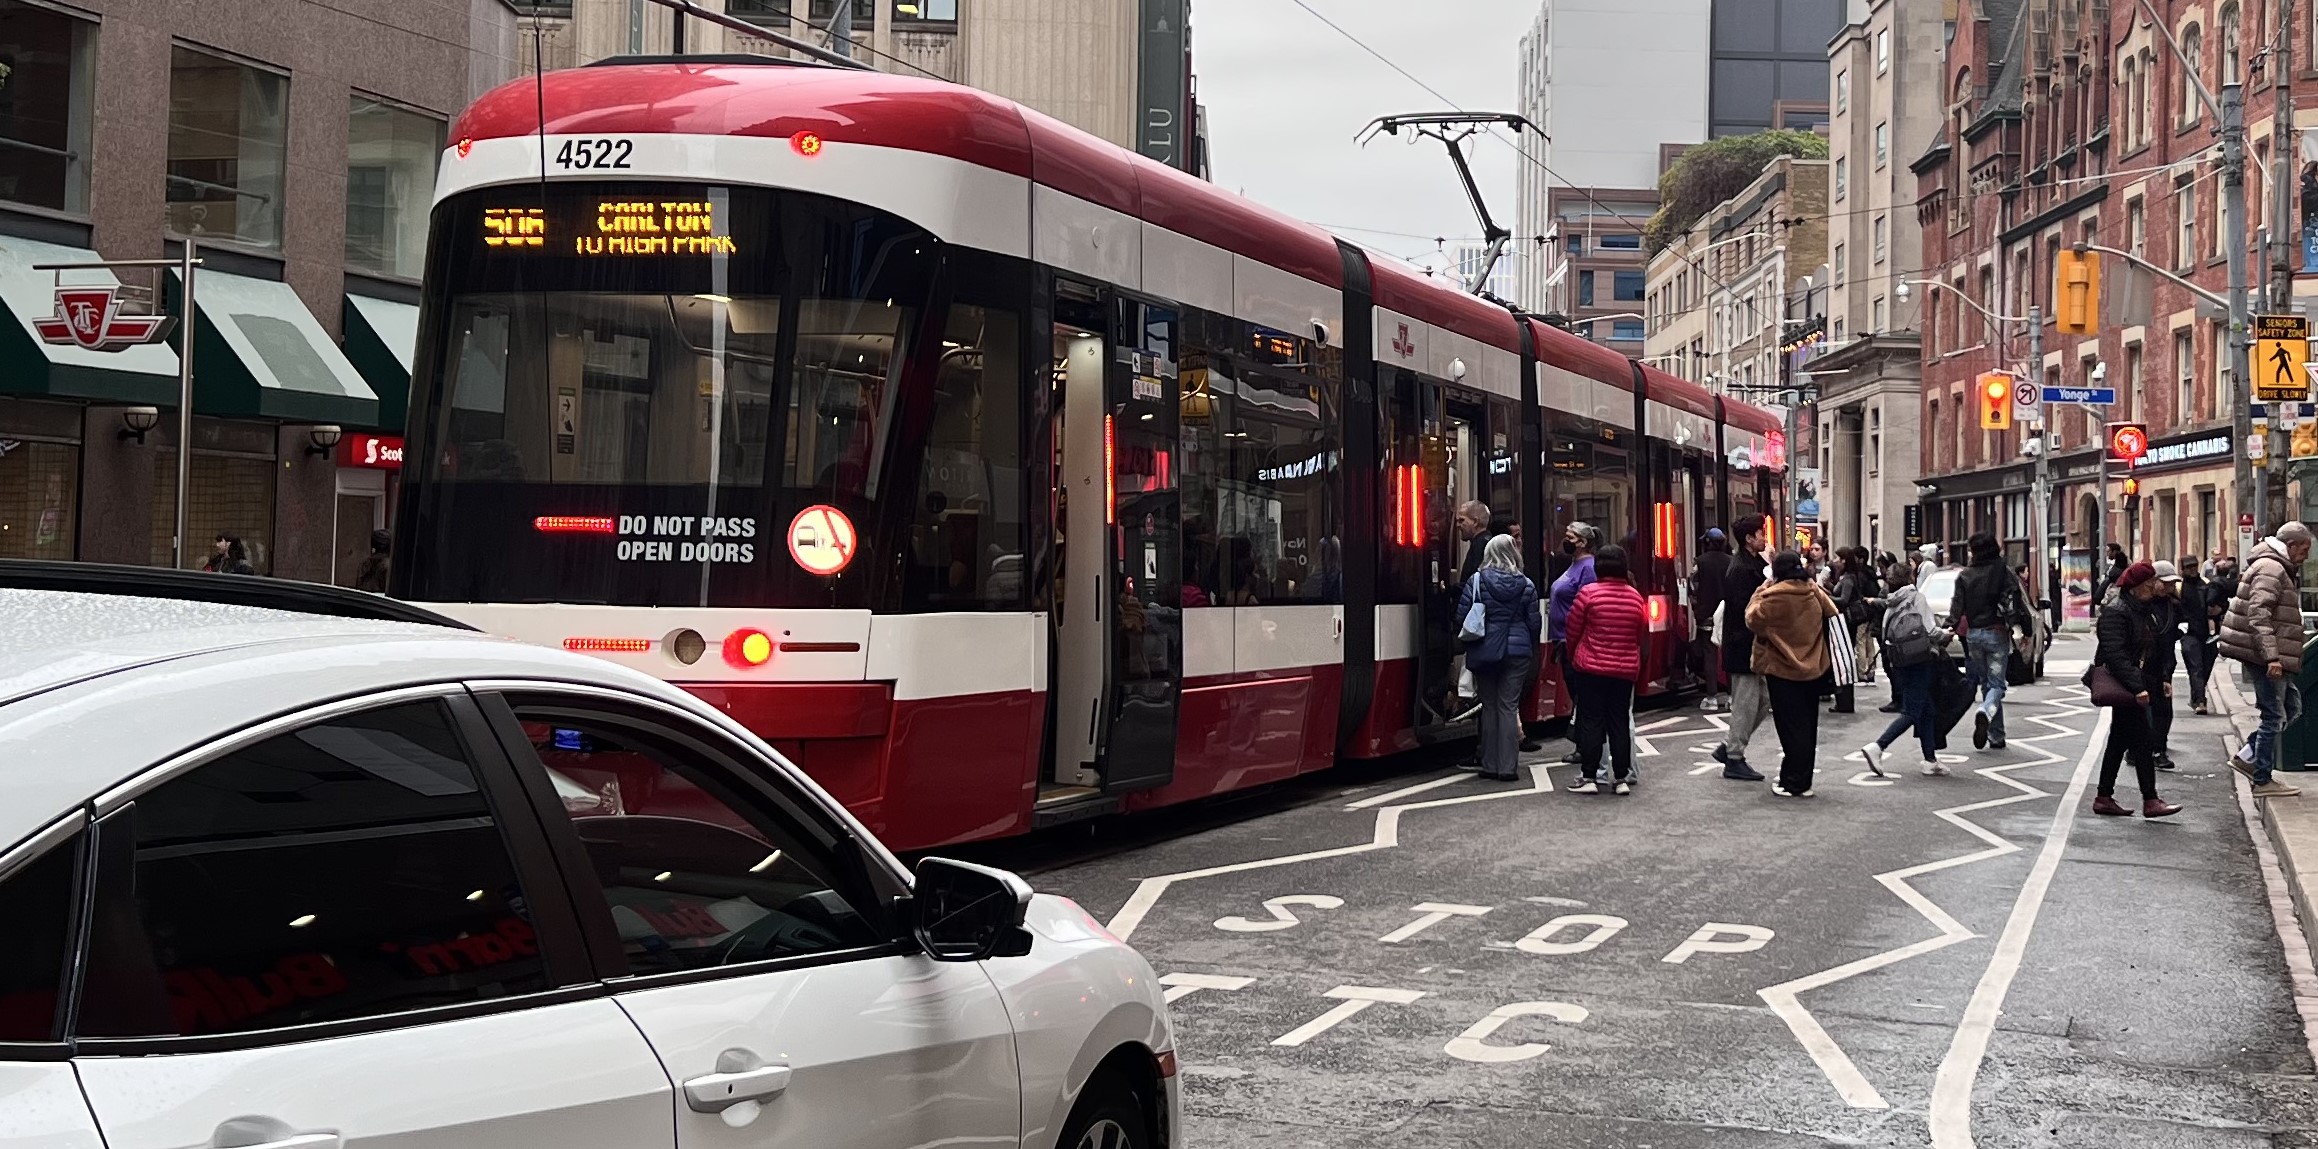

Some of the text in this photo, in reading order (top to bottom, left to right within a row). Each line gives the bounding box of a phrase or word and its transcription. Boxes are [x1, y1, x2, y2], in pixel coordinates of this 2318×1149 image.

[556, 139, 633, 169] 4522
[485, 208, 544, 248] 506
[598, 202, 712, 232] CARLTON
[576, 235, 737, 256] TO HIGH PARK
[2258, 328, 2305, 338] SAFETY ZONE
[2265, 318, 2298, 328] SENIORS
[2059, 388, 2090, 402] Yonge
[2258, 389, 2307, 399] DRIVE SLOWLY
[2158, 443, 2187, 463] SMOKE
[2186, 436, 2230, 458] CANNABIS
[618, 515, 756, 537] DO NOT PASS
[617, 541, 754, 563] OPEN DOORS
[1212, 894, 1776, 965] STOP
[1157, 971, 1590, 1063] TTC
